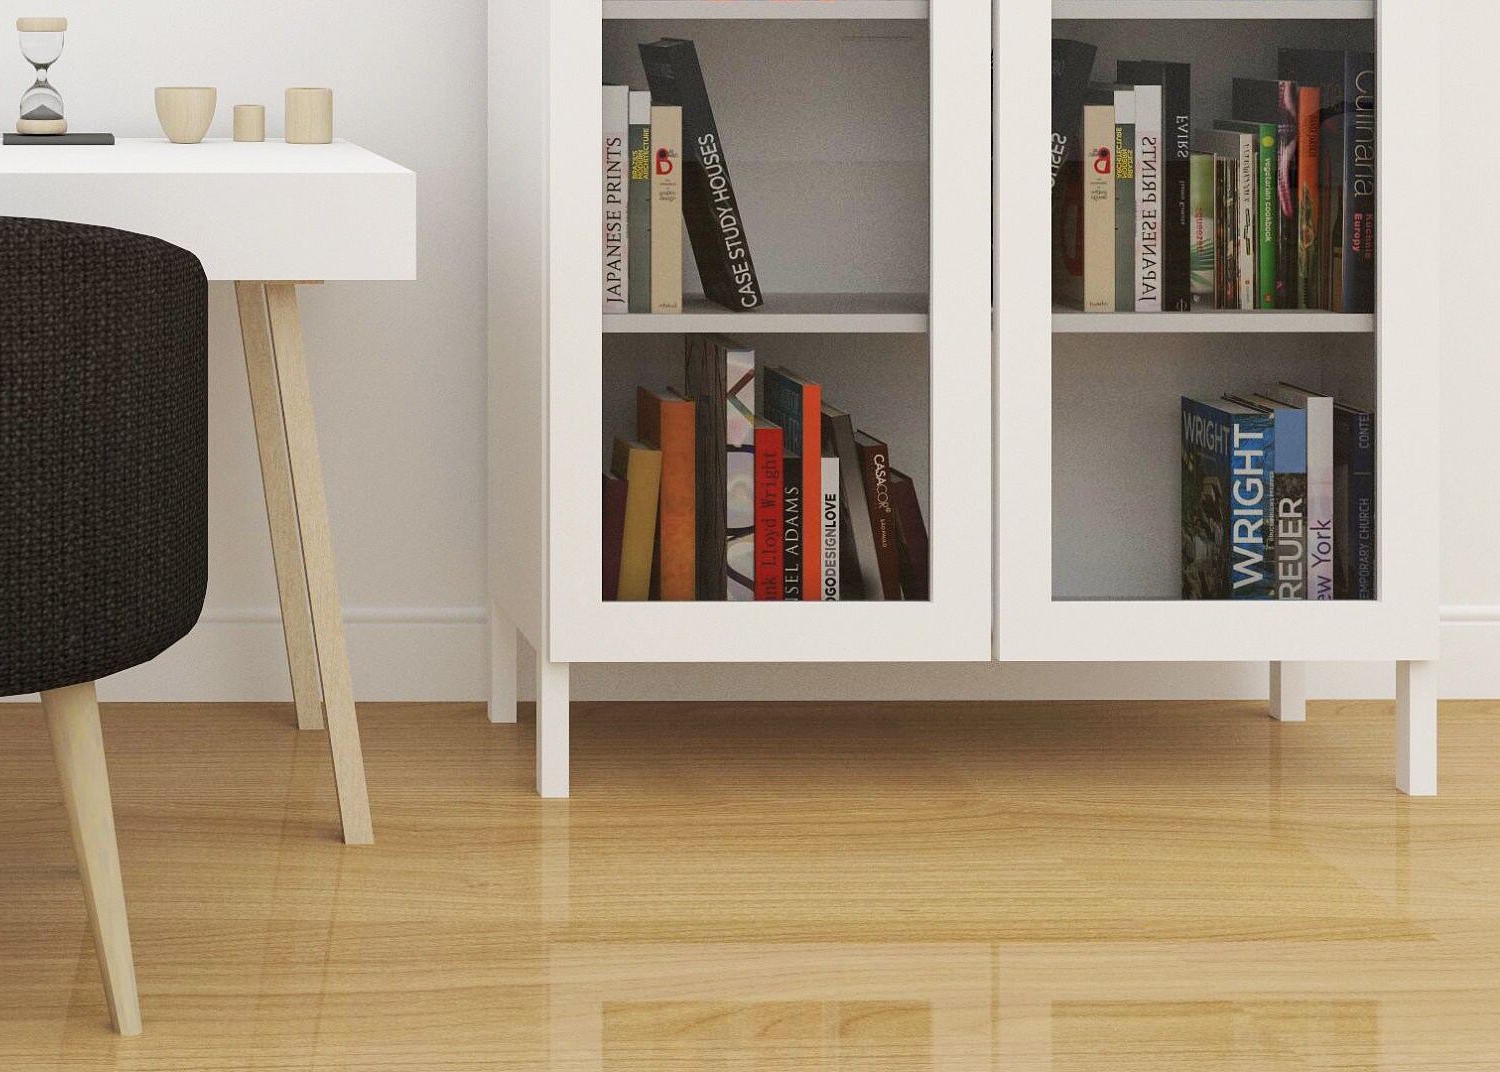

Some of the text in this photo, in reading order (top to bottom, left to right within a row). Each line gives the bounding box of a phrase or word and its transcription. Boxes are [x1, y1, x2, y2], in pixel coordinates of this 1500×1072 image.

[1354, 70, 1375, 198] Culinaria
[607, 137, 625, 303] JAPANESE PRINTS
[698, 133, 757, 308] CASE STUDY HOUSES
[1263, 158, 1272, 241] vegetarian cookbook
[1352, 213, 1363, 252] Europy
[1184, 411, 1229, 456] WRIGHT
[1359, 414, 1369, 449] CONTE
[761, 452, 778, 509] Wright
[1233, 424, 1263, 588] WRIGHT
[761, 518, 778, 566] Lloyd
[785, 486, 799, 555] ADAMS
[1279, 498, 1303, 600] REUER
[1310, 519, 1332, 568] York
[1359, 498, 1369, 599] EMPORARY CHURCH
